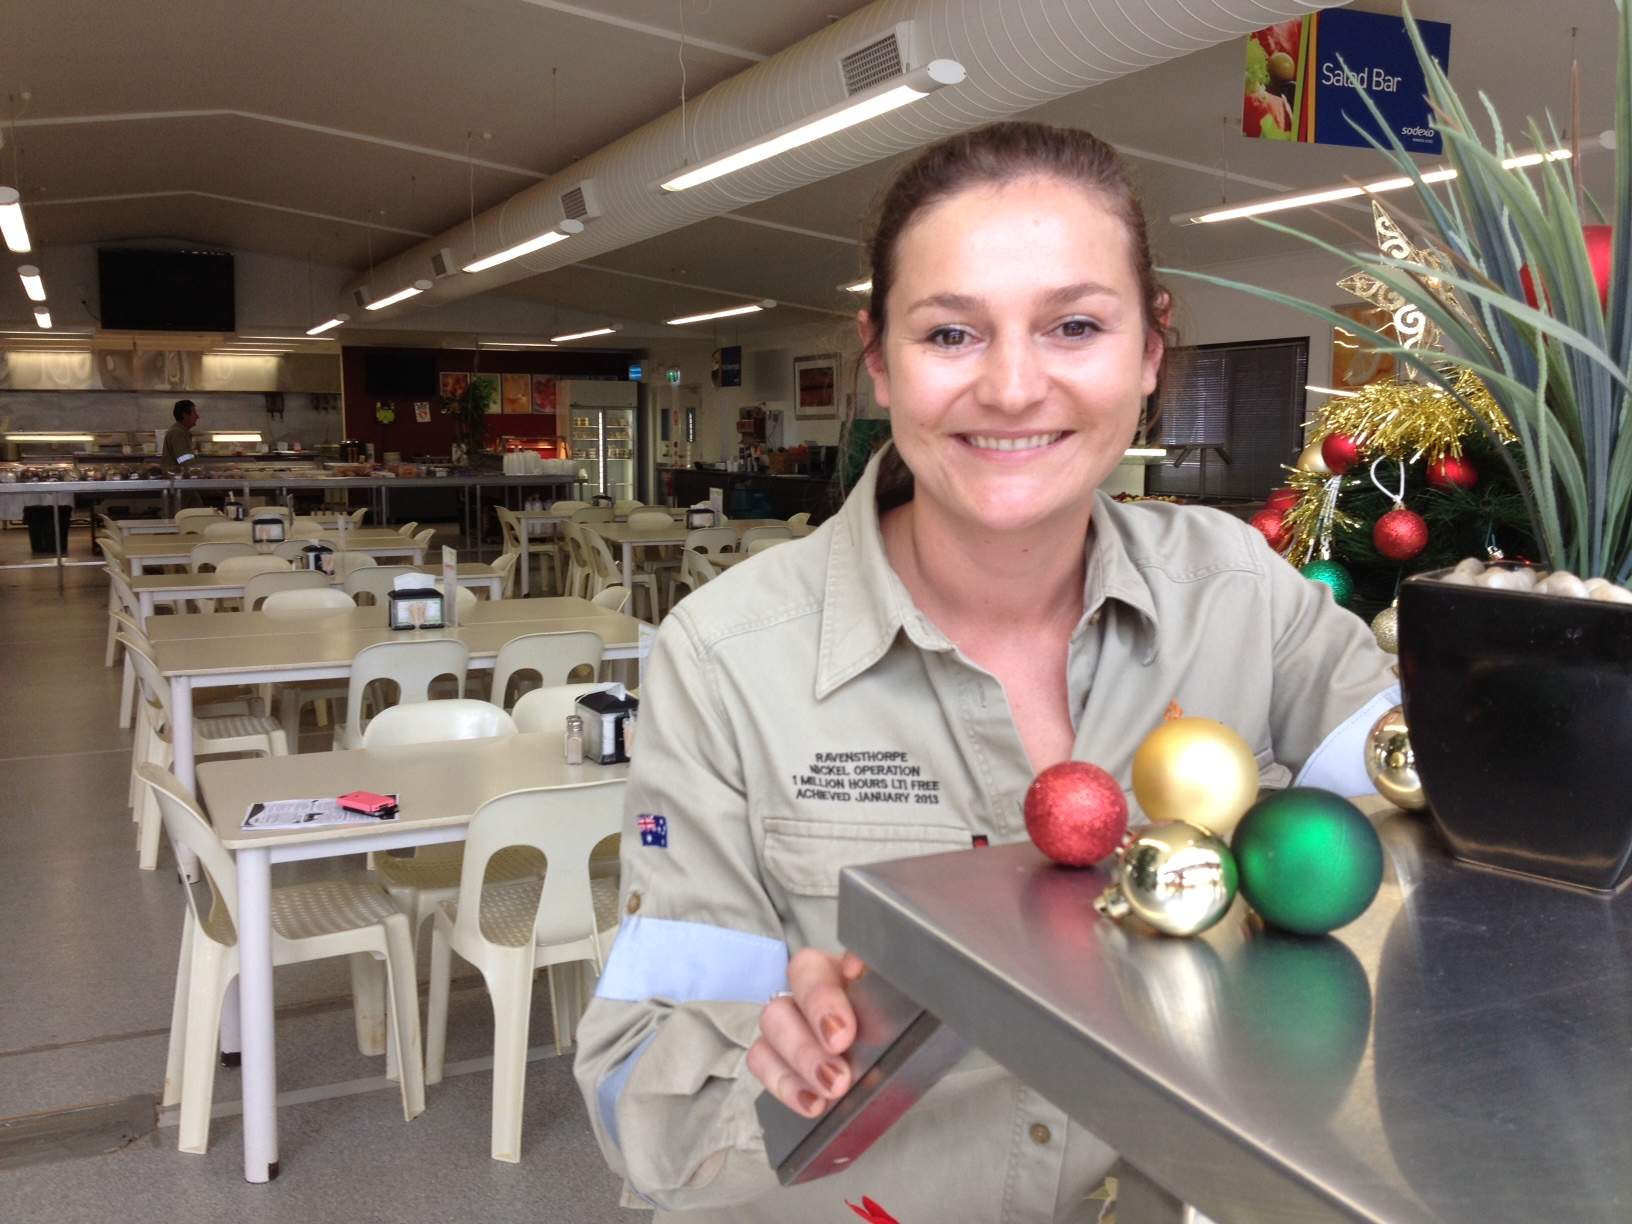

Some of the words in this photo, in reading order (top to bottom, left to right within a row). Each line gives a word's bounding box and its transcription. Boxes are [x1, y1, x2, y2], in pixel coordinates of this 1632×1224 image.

[1322, 62, 1368, 89] Salad
[1372, 68, 1402, 93] Bar
[1401, 126, 1434, 137] sodexo
[815, 752, 908, 763] RAVENSTHORPE
[809, 765, 850, 776] NICKEL
[854, 765, 920, 776] OPERATION
[792, 775, 797, 785] 1
[800, 776, 845, 789] MILLION
[849, 778, 888, 789] HOURS
[891, 779, 908, 790] LTI
[911, 780, 940, 791] FREE
[796, 788, 851, 802] ACHIEVED
[855, 791, 909, 803] JANUARY
[914, 793, 940, 804] 2013
